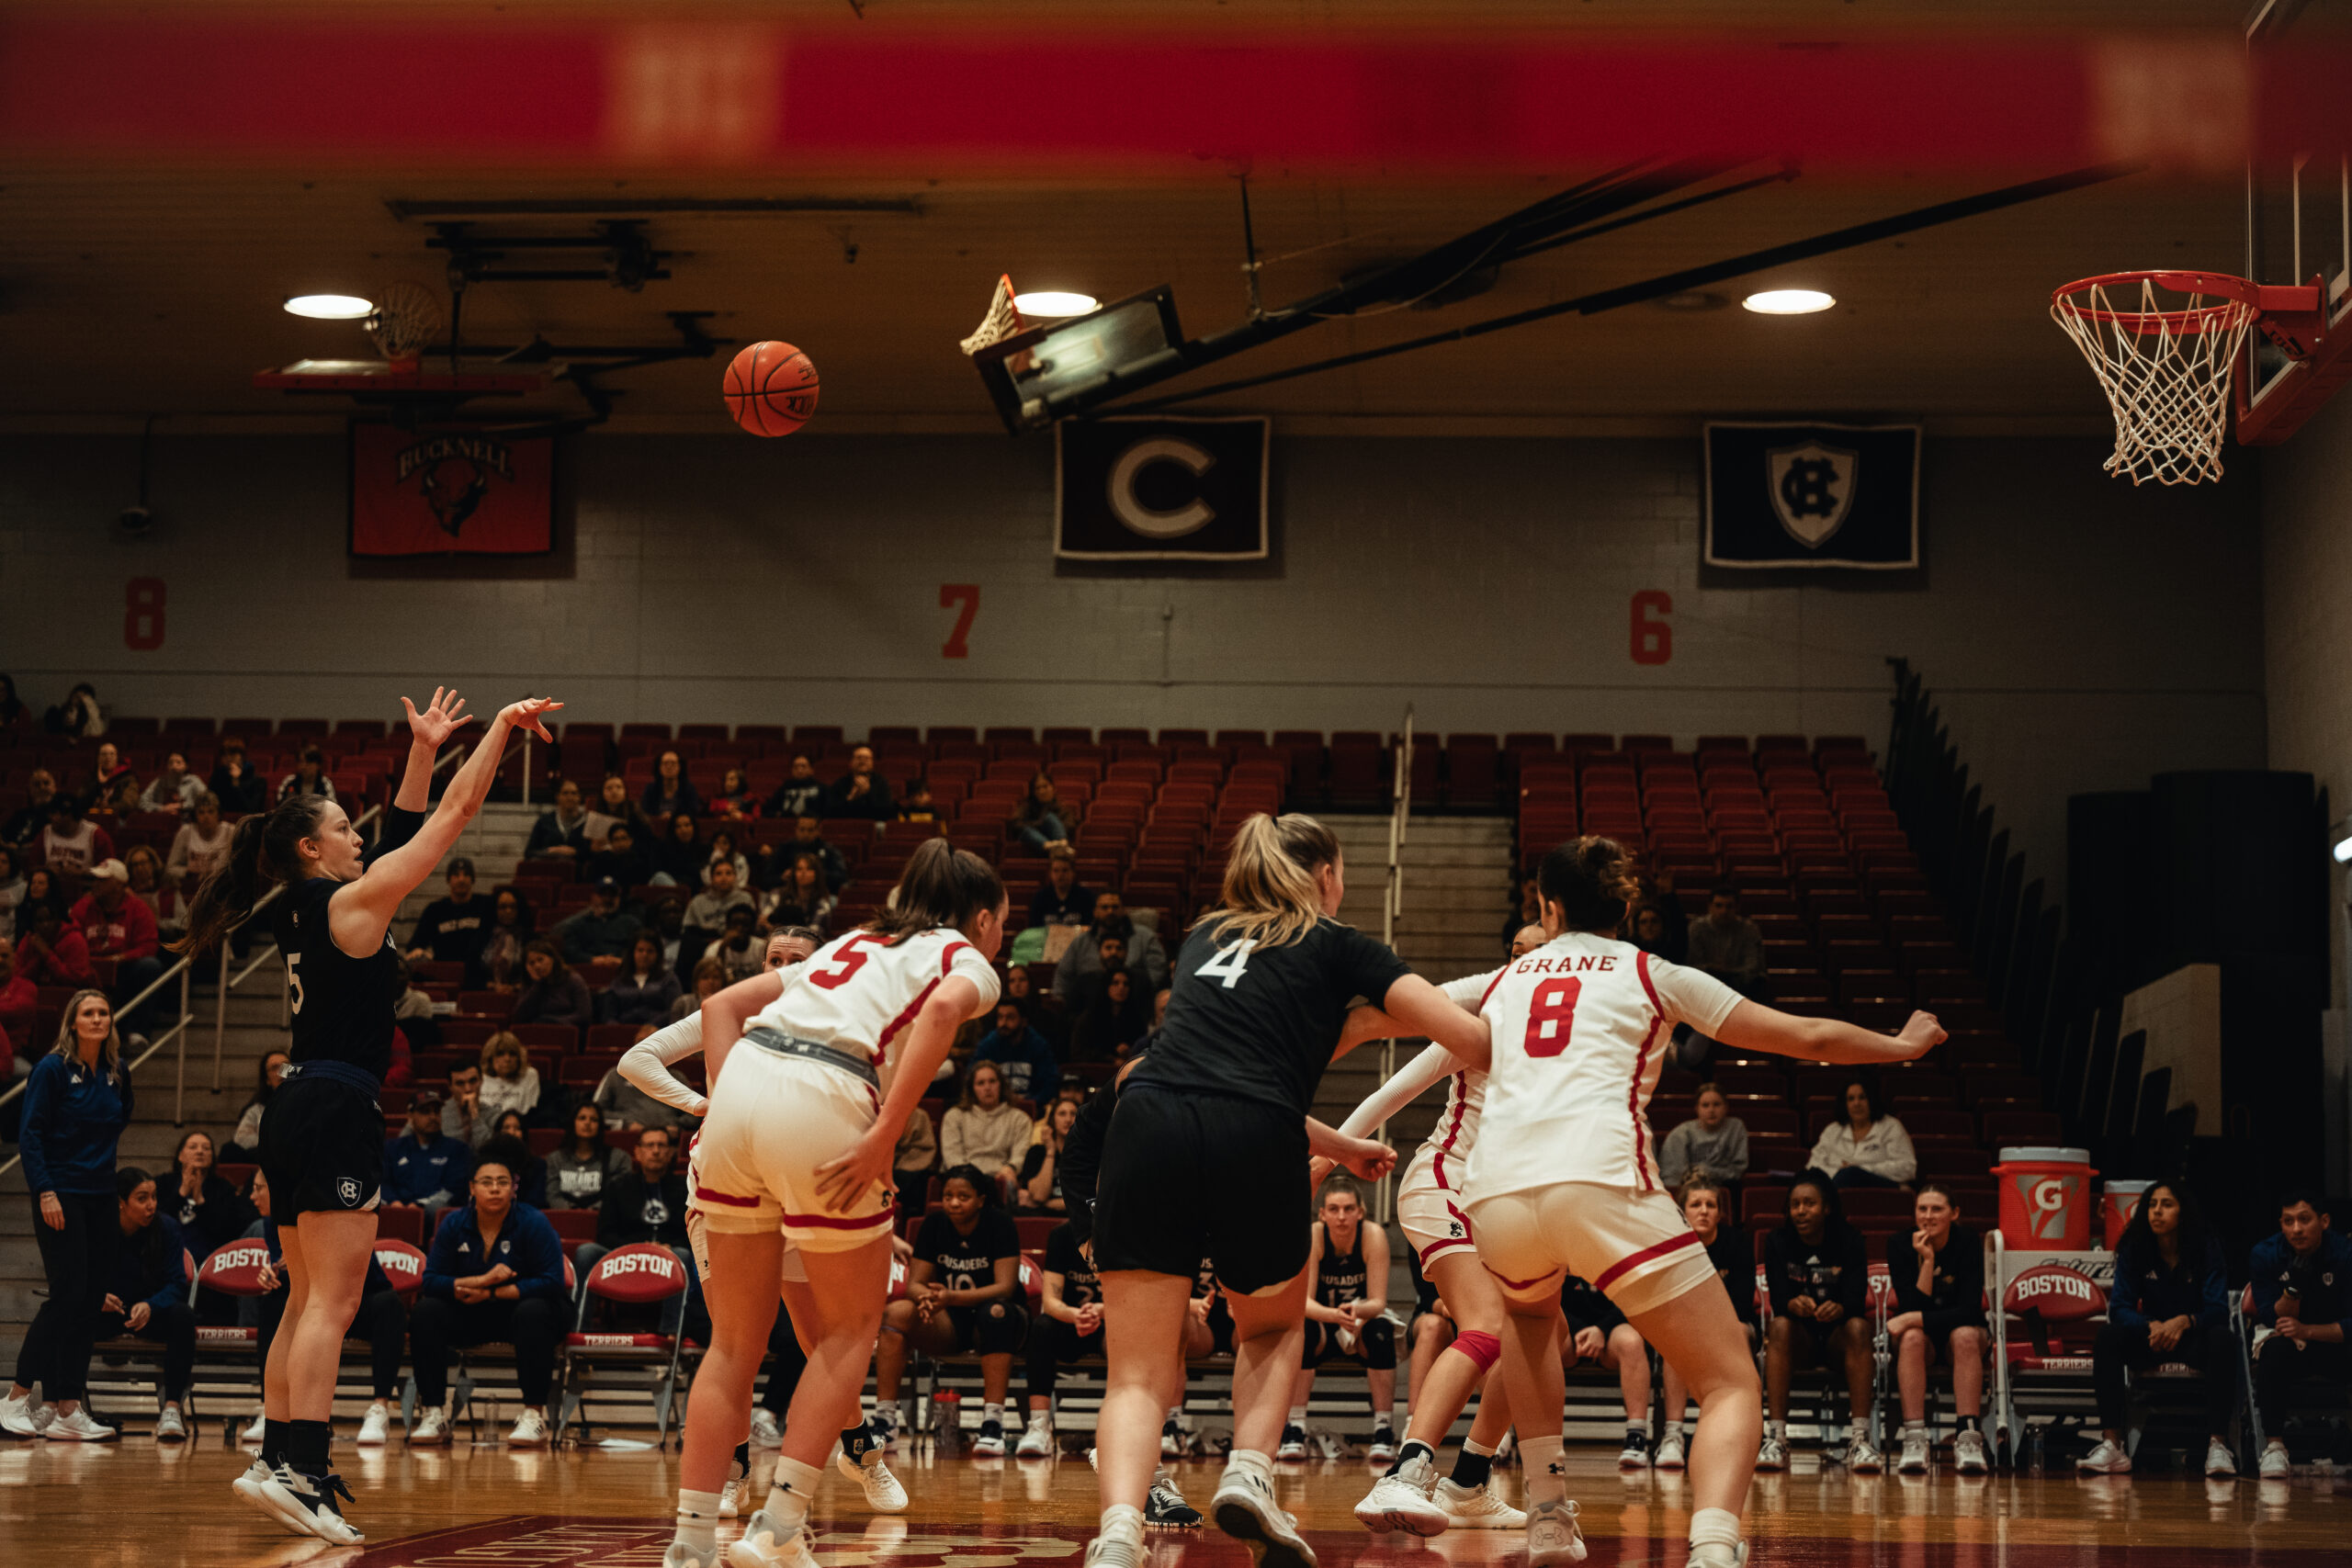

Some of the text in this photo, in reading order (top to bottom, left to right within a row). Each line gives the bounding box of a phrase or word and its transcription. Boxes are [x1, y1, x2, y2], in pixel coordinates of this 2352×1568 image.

[398, 435, 514, 481] BUCKNELL
[1106, 434, 1216, 539] C
[125, 577, 166, 651] 8
[940, 583, 980, 659] 7
[1630, 590, 1672, 665] 6
[808, 934, 892, 990] 5
[1193, 938, 1259, 989] 4
[1516, 955, 1618, 975] GRANE
[286, 952, 305, 1015] 5
[1523, 976, 1582, 1058] 8
[2034, 1179, 2064, 1212] G
[212, 1247, 271, 1274] BOSTO
[601, 1253, 674, 1280] BOSTON
[936, 1253, 990, 1272] CRUSADERS
[2016, 1274, 2092, 1302] BOSTON
[197, 1328, 248, 1341] TERRIERS
[583, 1335, 635, 1347] TERRIERS
[2041, 1358, 2094, 1370] TERRIERS
